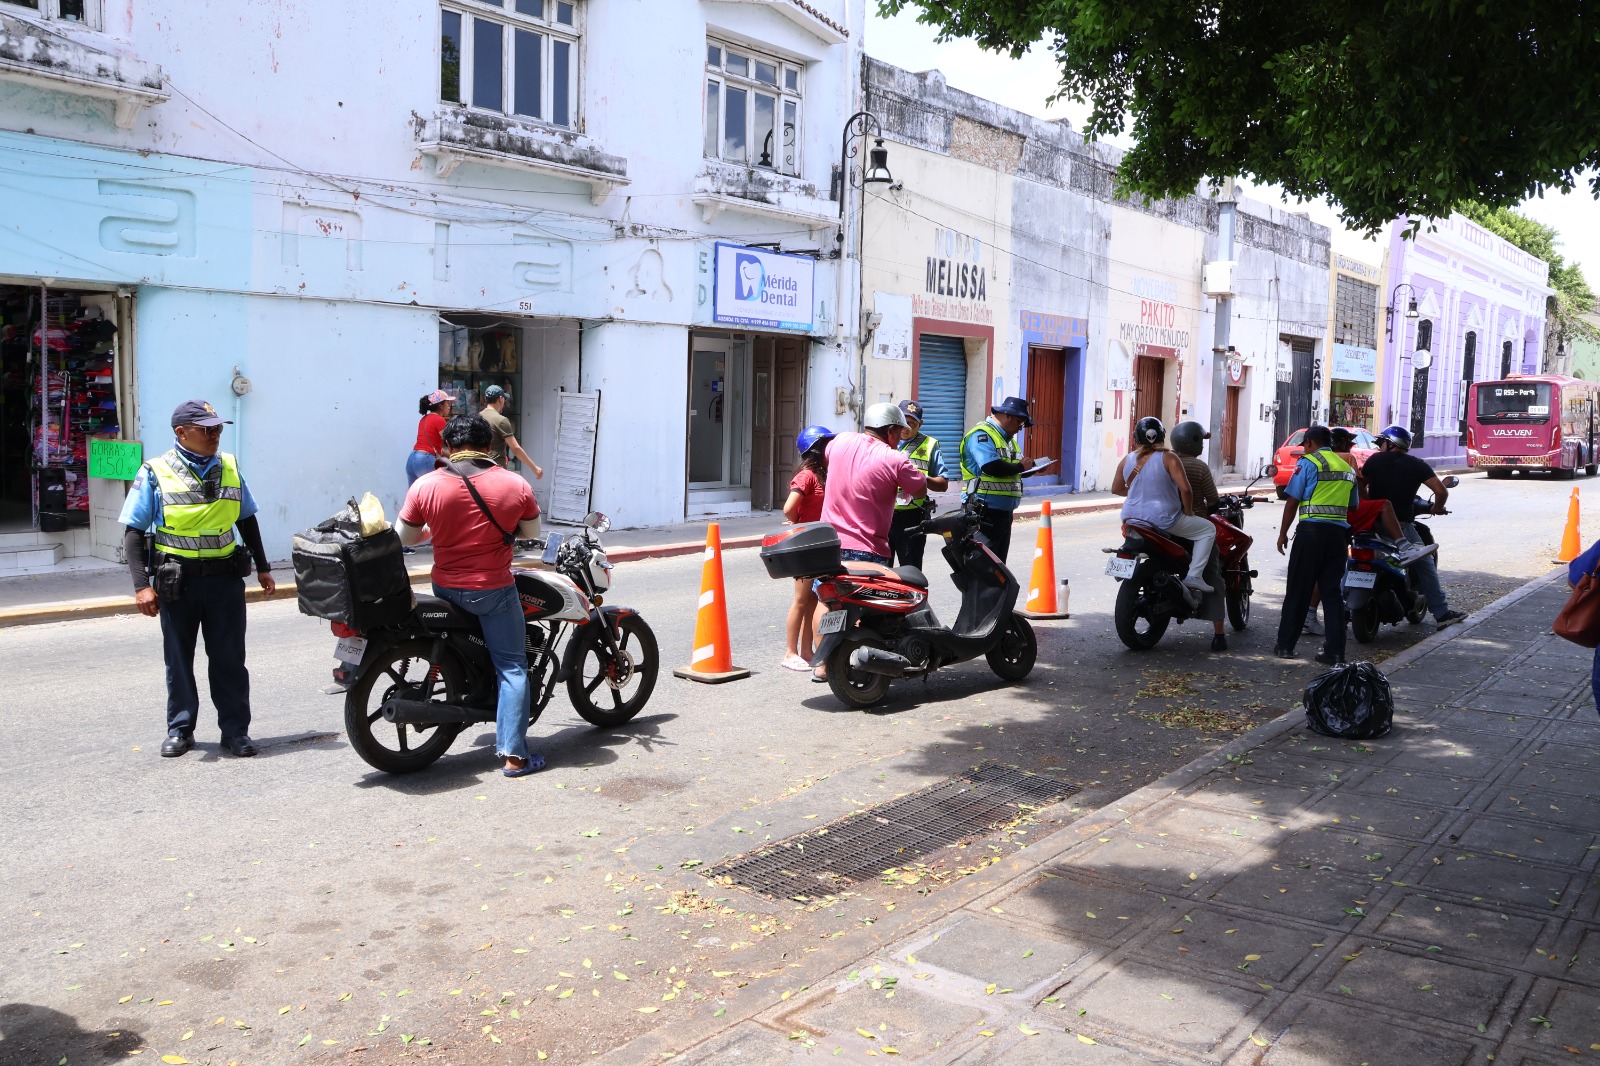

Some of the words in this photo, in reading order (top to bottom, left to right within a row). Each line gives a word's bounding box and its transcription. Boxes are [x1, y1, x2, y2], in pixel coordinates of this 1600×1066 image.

[761, 274, 798, 291] Mérida
[926, 257, 986, 302] MELISSA
[519, 301, 532, 311] 551
[761, 290, 797, 307] Dental
[1020, 310, 1088, 336] SEXOPOLIS
[1140, 300, 1175, 329] PAKITO
[1120, 322, 1153, 343] MAYOREO
[1160, 328, 1190, 348] MENUDEO
[1313, 358, 1321, 391] SAN
[91, 443, 125, 457] GORRAS
[130, 446, 136, 458] A
[338, 643, 362, 656] FAVORIT
